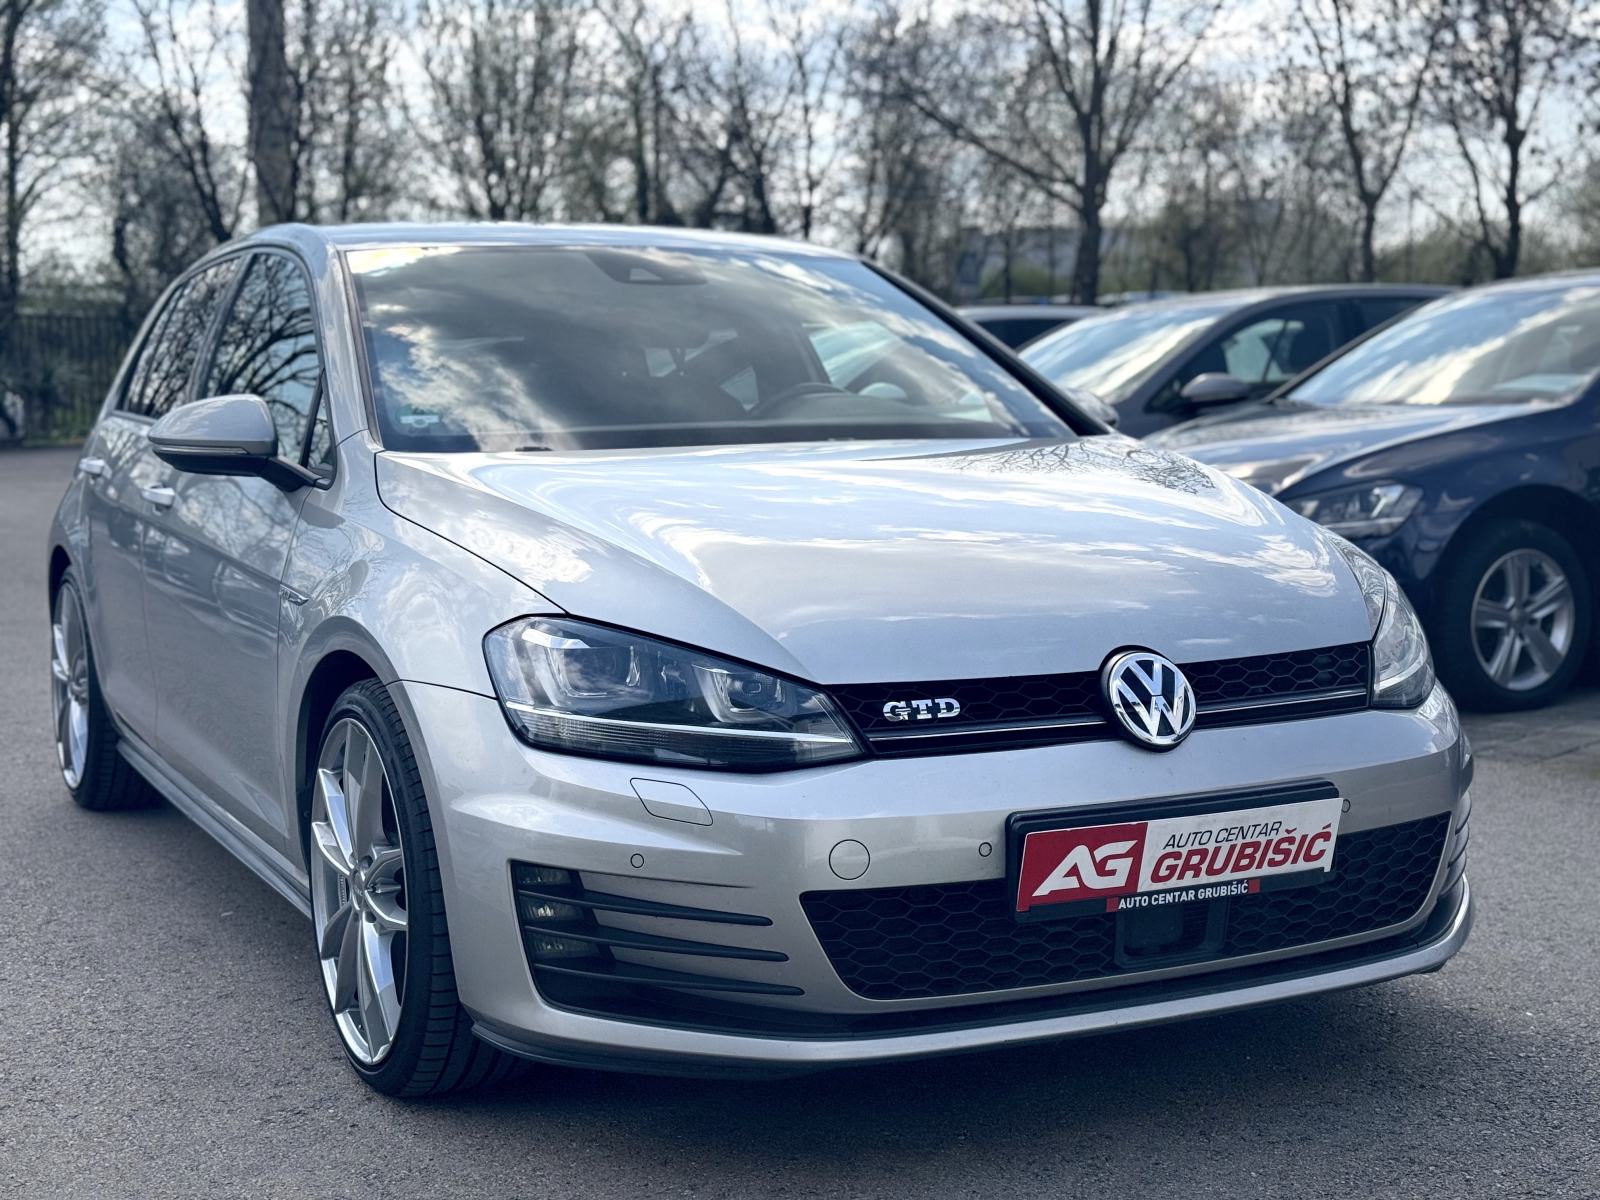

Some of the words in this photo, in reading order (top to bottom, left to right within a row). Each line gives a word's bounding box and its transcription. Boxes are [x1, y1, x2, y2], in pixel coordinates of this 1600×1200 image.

[882, 697, 961, 722] GTD
[1109, 651, 1197, 747] VW
[1150, 822, 1333, 884] GRUBIŠIĆ
[1163, 830, 1213, 850] AUTO
[1214, 821, 1283, 846] CENTAR
[1031, 839, 1139, 897] AG
[1118, 895, 1149, 910] AUTO
[1150, 889, 1196, 905] CENTAR
[1197, 880, 1250, 900] GRUBIŠIĆ
